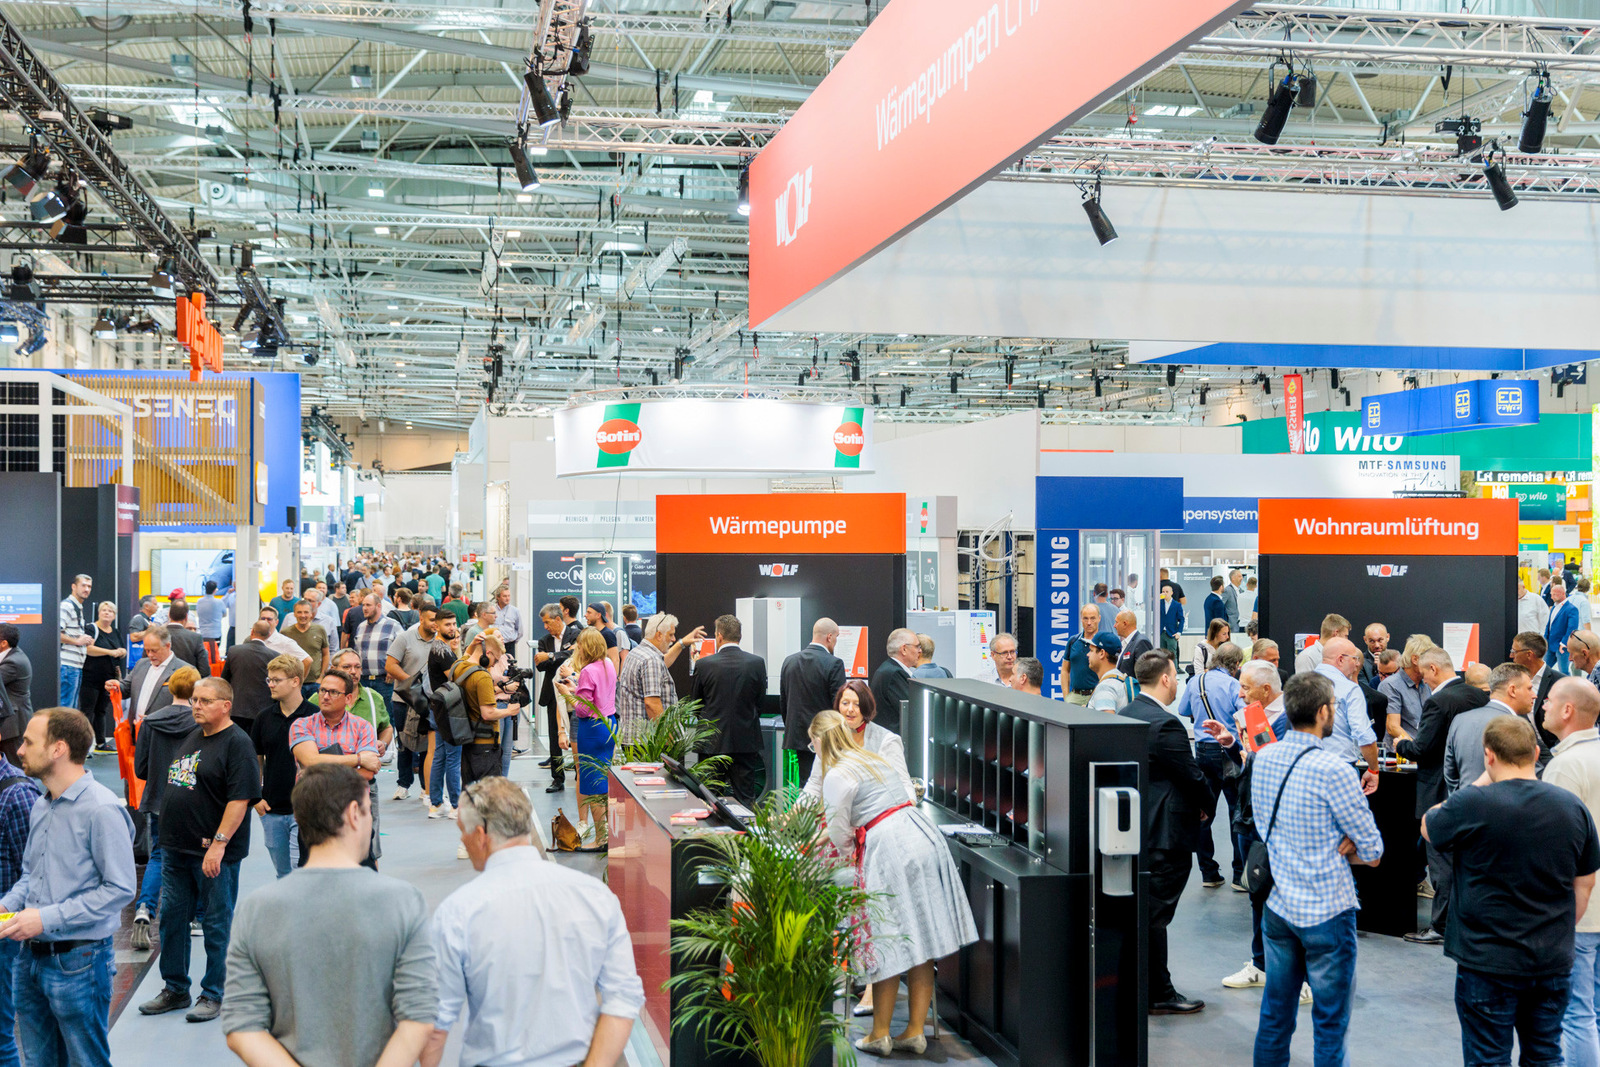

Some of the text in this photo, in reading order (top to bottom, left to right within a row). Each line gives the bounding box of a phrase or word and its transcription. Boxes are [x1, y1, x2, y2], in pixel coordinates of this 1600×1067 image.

[876, 3, 999, 151] Wärmepumpen
[775, 165, 813, 247] WOLF
[1498, 391, 1520, 404] EC
[596, 430, 640, 443] Sotin
[834, 432, 864, 444] Sotin
[1529, 491, 1548, 501] wilo
[709, 516, 847, 538] Wärmepumpe
[1294, 518, 1480, 540] Wohnraumlüftung
[758, 564, 799, 577] WOLF
[1366, 565, 1408, 578] WOLF
